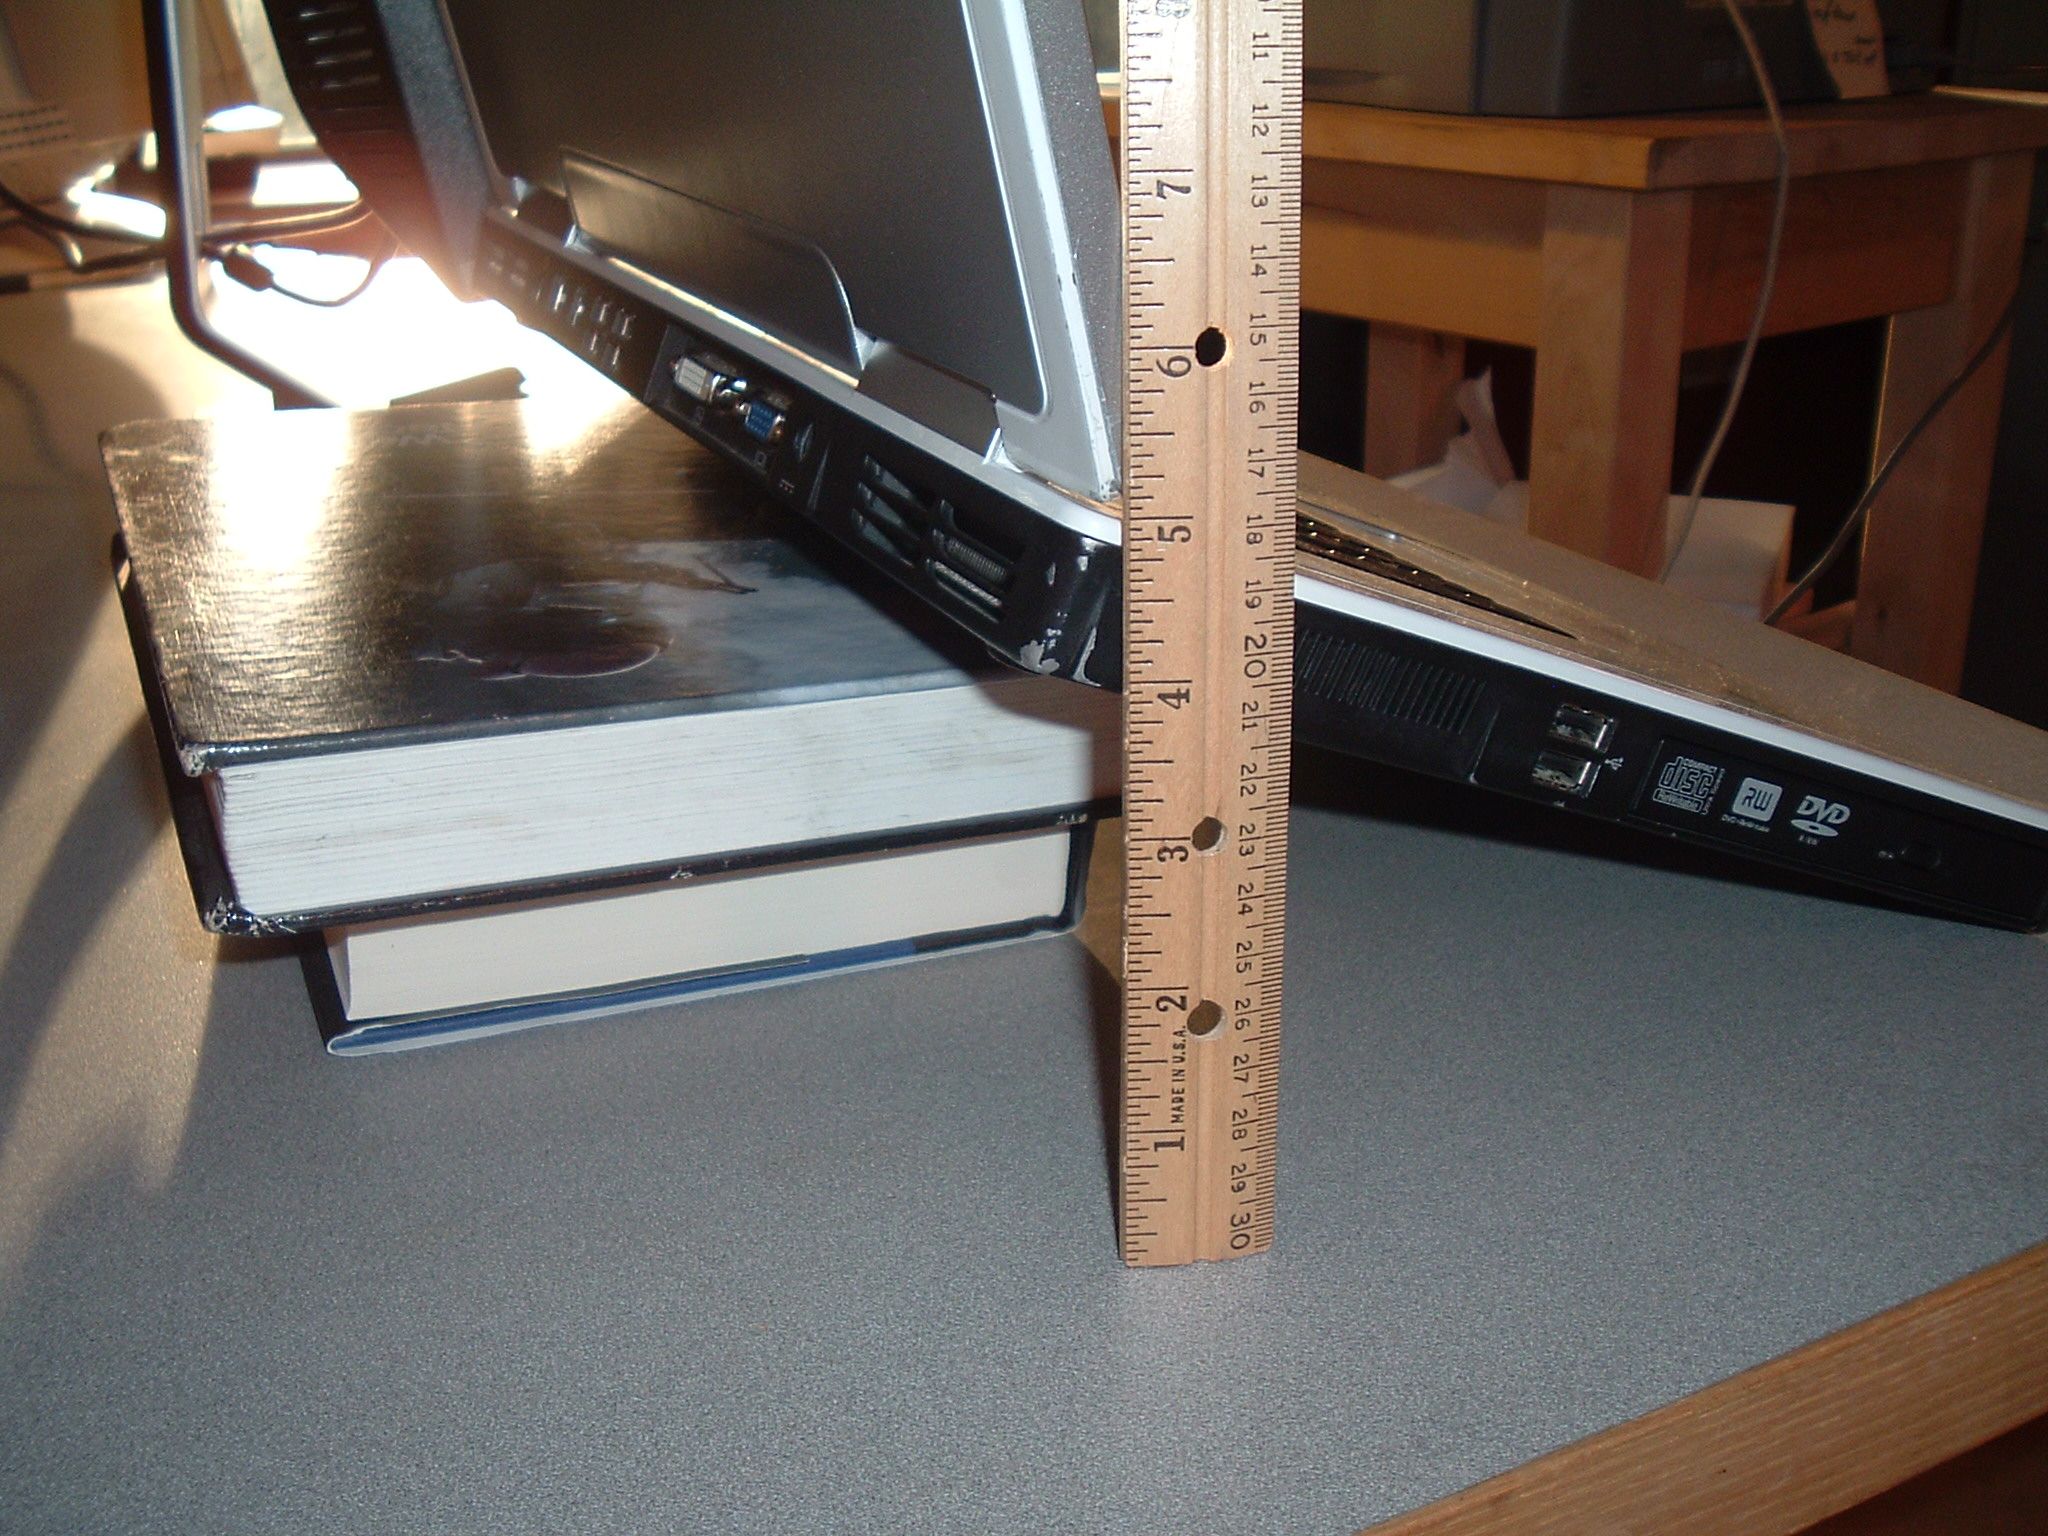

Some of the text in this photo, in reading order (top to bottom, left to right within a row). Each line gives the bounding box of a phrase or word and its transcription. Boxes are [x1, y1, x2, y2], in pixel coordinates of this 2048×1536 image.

[1252, 32, 1270, 61] 11
[1252, 103, 1270, 138] 12
[1156, 179, 1192, 200] 7
[1251, 174, 1269, 208] 13
[1250, 244, 1268, 278] 14
[1249, 313, 1267, 346] 15
[1156, 355, 1192, 378] 6
[1249, 381, 1266, 414] 16
[1248, 448, 1265, 479] 17
[1157, 524, 1192, 544] 5
[1246, 514, 1264, 546] 18
[1245, 579, 1263, 610] 19
[1244, 633, 1268, 679] 20
[1157, 687, 1191, 710] 4
[1242, 700, 1259, 732] 21
[1240, 762, 1258, 797] 22
[1741, 786, 1774, 812] RW
[1796, 795, 1851, 825] DVD
[1157, 845, 1189, 863] 3
[1239, 823, 1257, 857] 23
[1237, 882, 1255, 916] 24
[1236, 940, 1253, 974] 25
[1156, 995, 1188, 1013] 2
[1235, 998, 1251, 1031] 26
[1171, 1025, 1187, 1124] MADE IN U.S.A.
[1233, 1053, 1250, 1084] 27
[1232, 1108, 1249, 1141] 28
[1154, 1136, 1185, 1152] 1
[1231, 1163, 1248, 1194] 29
[1230, 1212, 1251, 1250] 30
